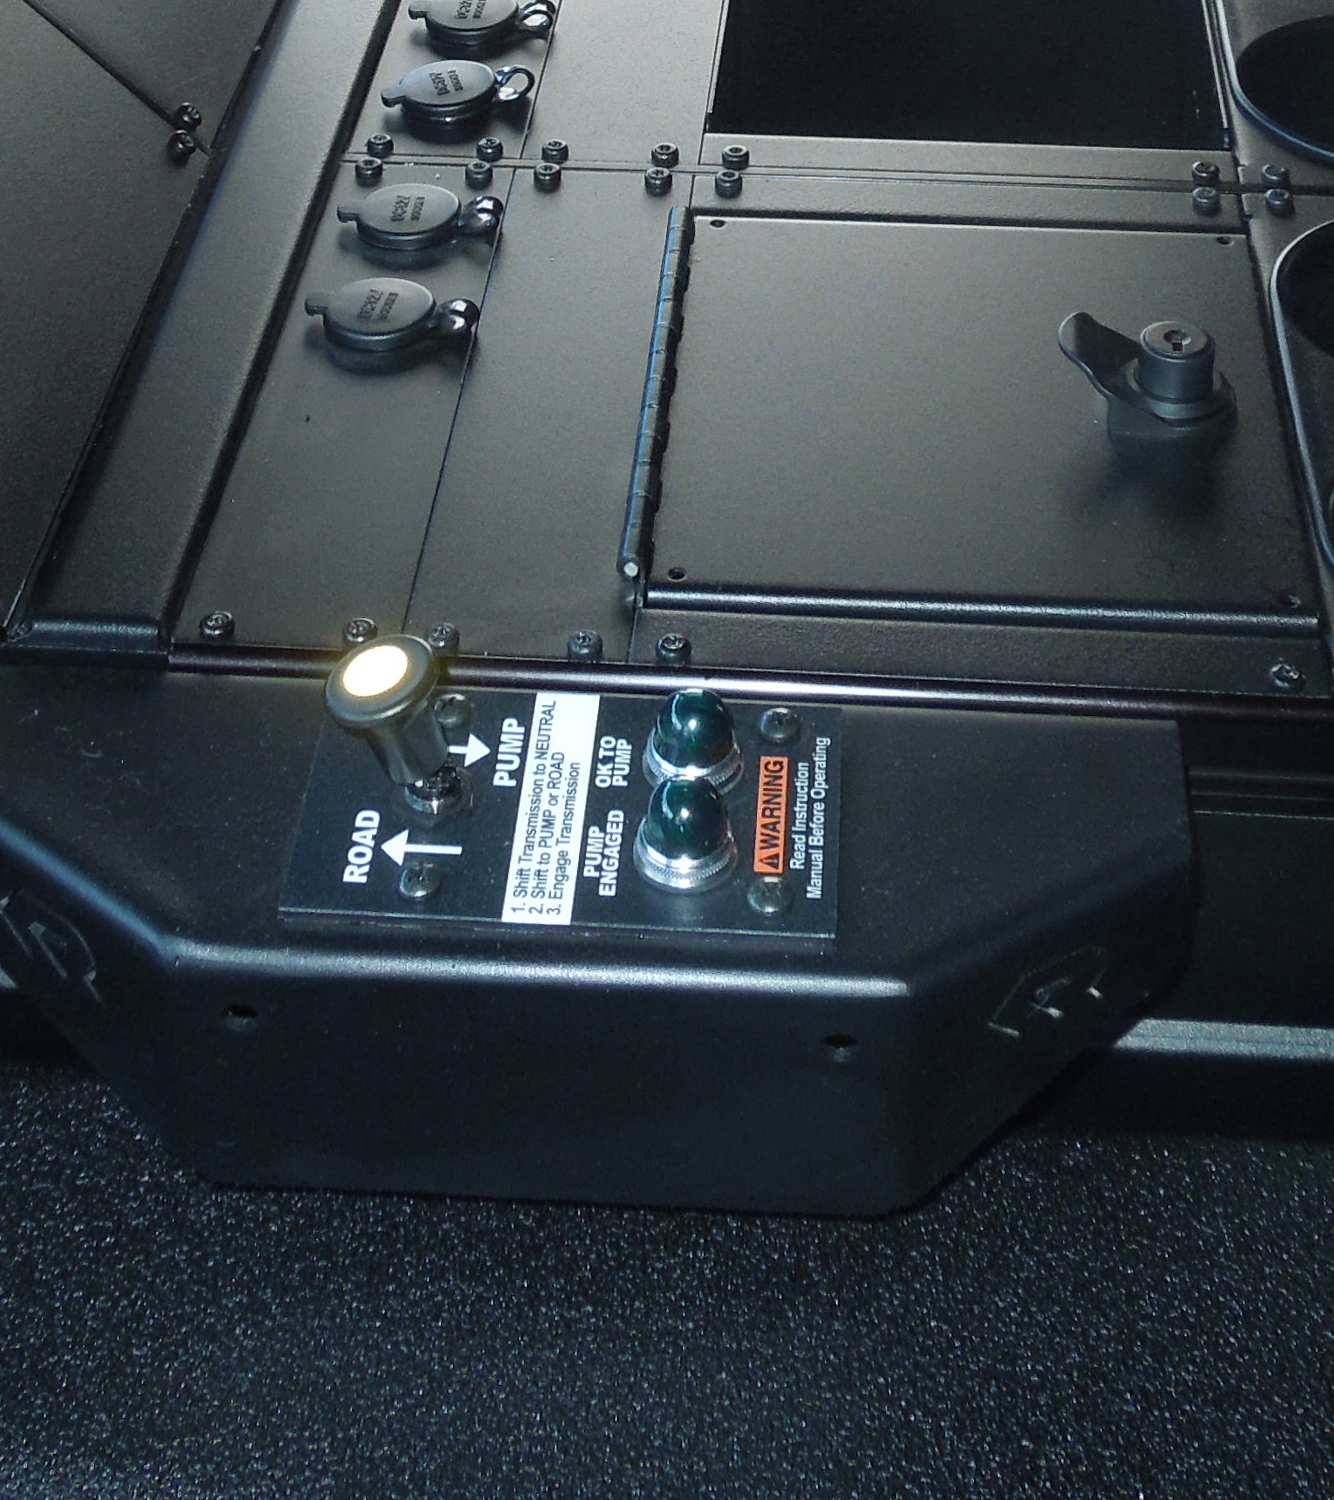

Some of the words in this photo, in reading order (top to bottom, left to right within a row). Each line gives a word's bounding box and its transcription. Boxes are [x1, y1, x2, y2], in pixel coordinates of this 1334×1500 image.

[493, 717, 525, 787] PUMP
[534, 700, 556, 760] NEUTRAL
[598, 736, 616, 759] TO
[532, 763, 546, 775] to
[547, 752, 565, 790] ROAD
[595, 762, 613, 788] OK
[612, 738, 632, 787] PUMP
[810, 736, 831, 799] Operating
[548, 793, 559, 806] or
[556, 762, 580, 847] Transmission
[760, 760, 784, 850] WARNING
[792, 761, 809, 832] Instruction
[518, 779, 544, 863] Transmission
[538, 809, 556, 848] PUMP
[808, 801, 825, 846] Before
[343, 809, 381, 884] ROAD
[536, 852, 550, 866] to
[583, 825, 605, 877] PUMP
[598, 809, 624, 897] ENGAGED
[790, 835, 806, 870] Read
[513, 867, 531, 898] Shift
[531, 867, 549, 899] Shift
[548, 850, 571, 900] Engage
[806, 849, 823, 899] Manual
[511, 903, 525, 913] 1.
[529, 903, 544, 915] 2.
[547, 904, 561, 915] 3.
